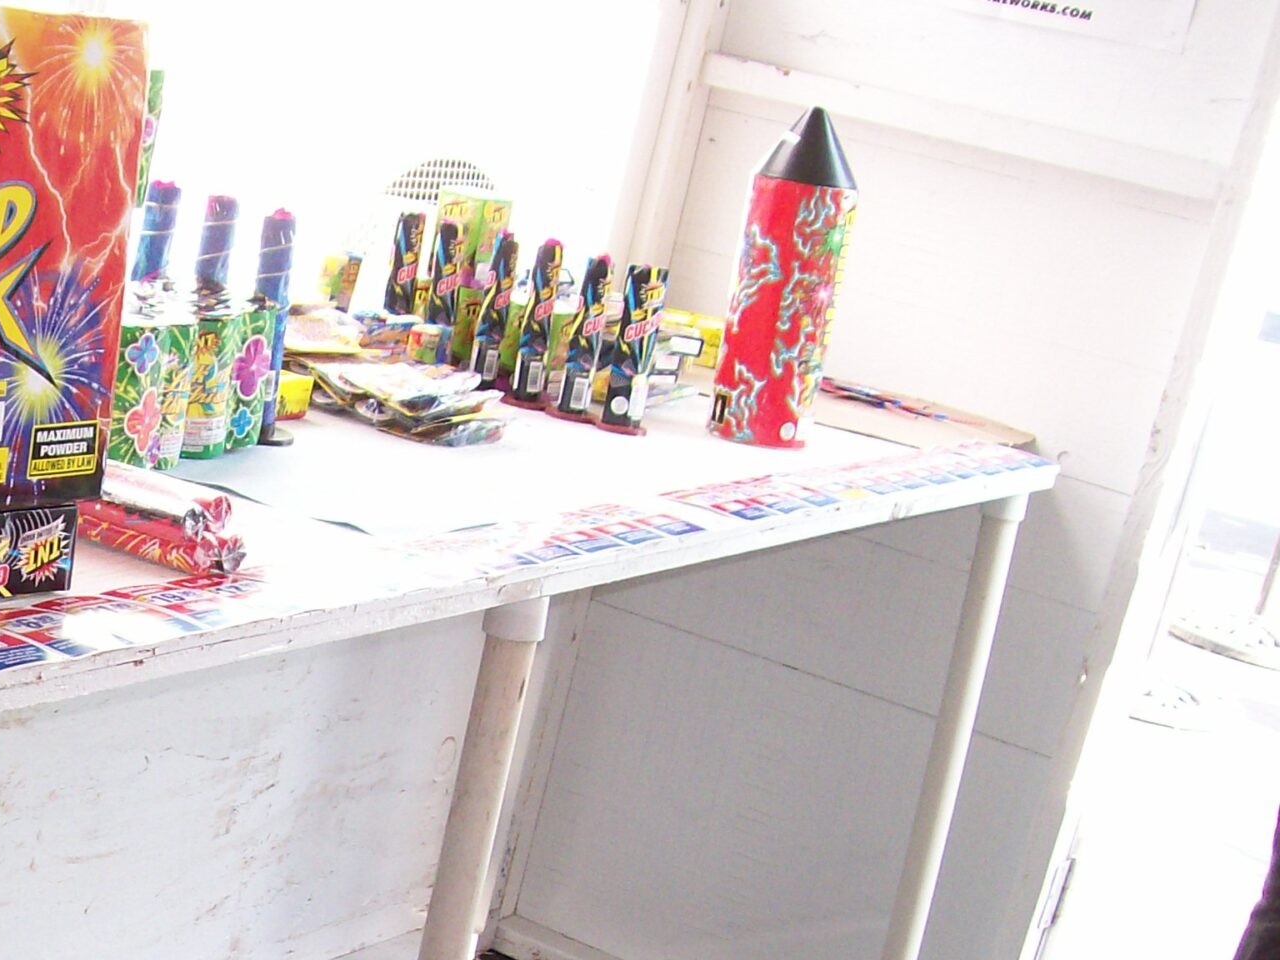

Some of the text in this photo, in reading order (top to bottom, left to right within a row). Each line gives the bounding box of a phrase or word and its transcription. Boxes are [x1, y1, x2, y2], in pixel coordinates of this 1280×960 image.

[36, 426, 95, 444] MAXIMUM
[39, 441, 88, 457] POWDER
[32, 455, 93, 472] ALLOWED BY LAW
[27, 538, 63, 573] TNT
